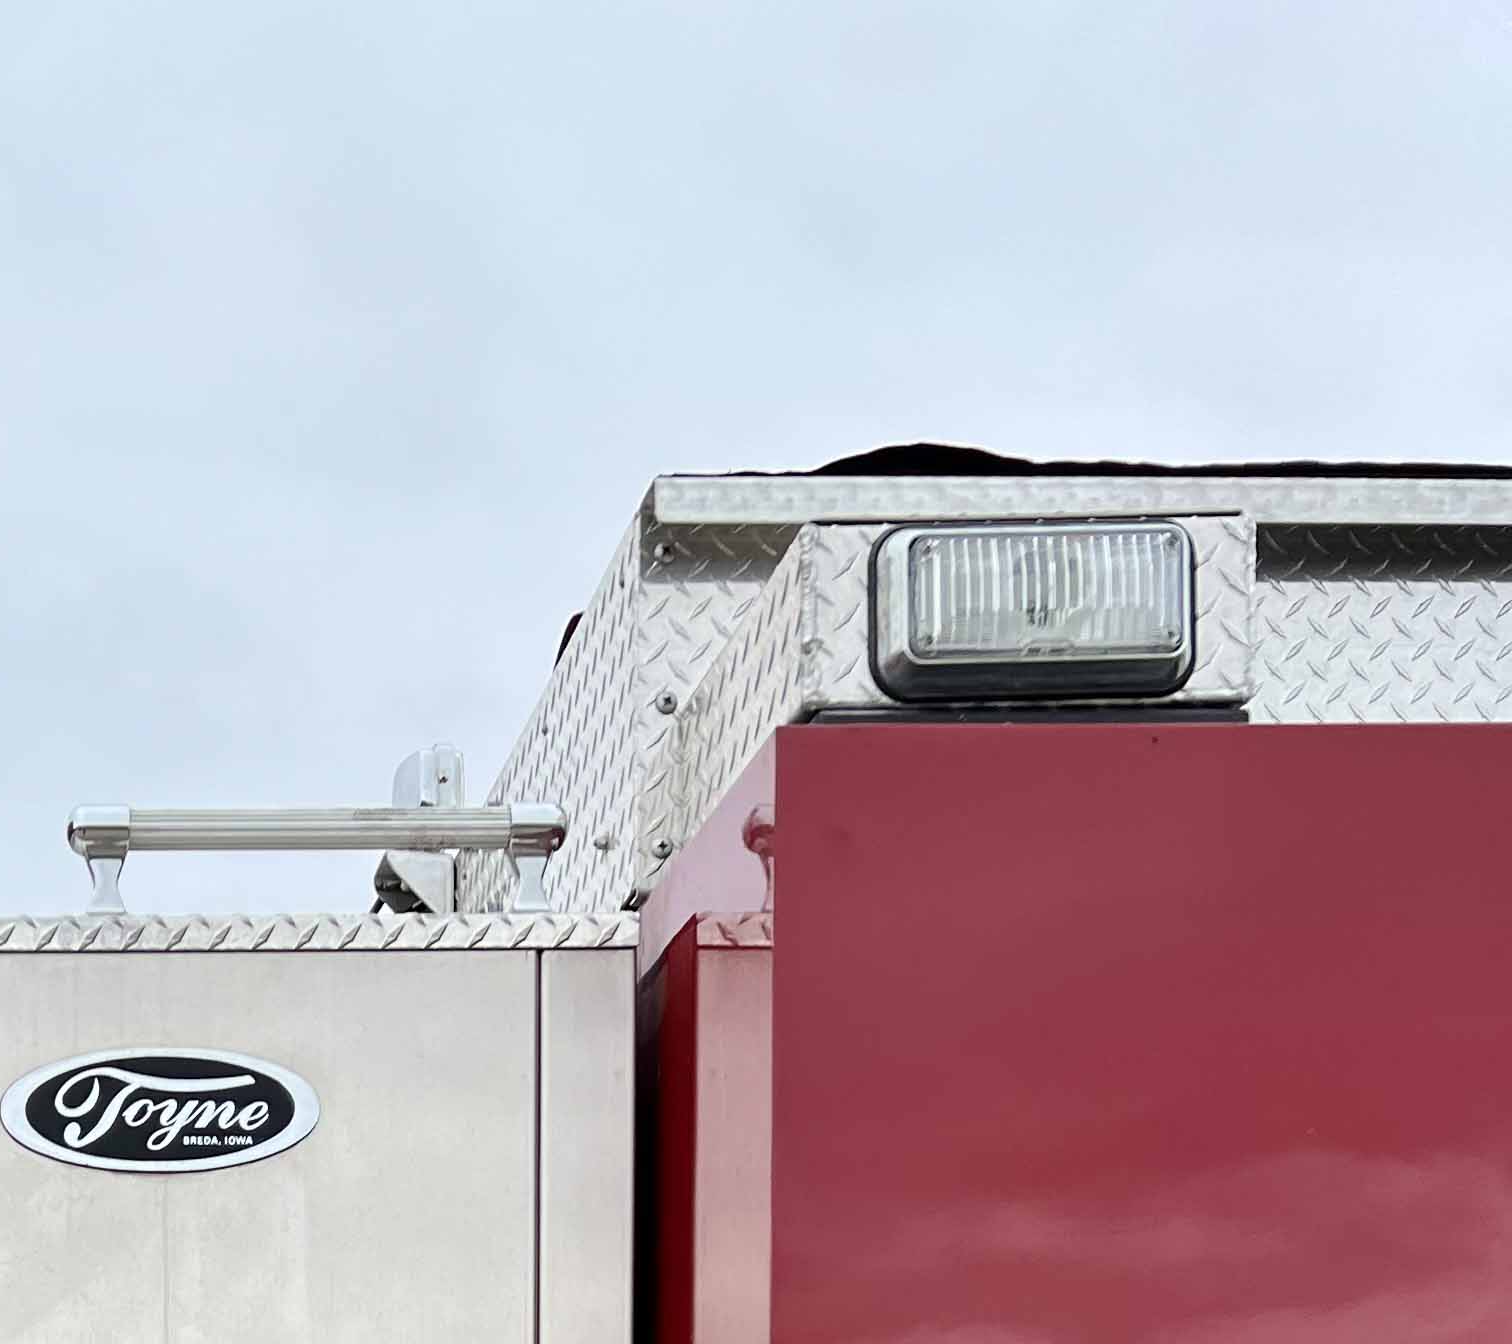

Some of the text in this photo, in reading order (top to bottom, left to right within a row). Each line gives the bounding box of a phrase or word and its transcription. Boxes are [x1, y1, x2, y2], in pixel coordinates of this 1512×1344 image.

[54, 1066, 269, 1150] Toyne
[183, 1135, 253, 1146] BREDA, IOWA
